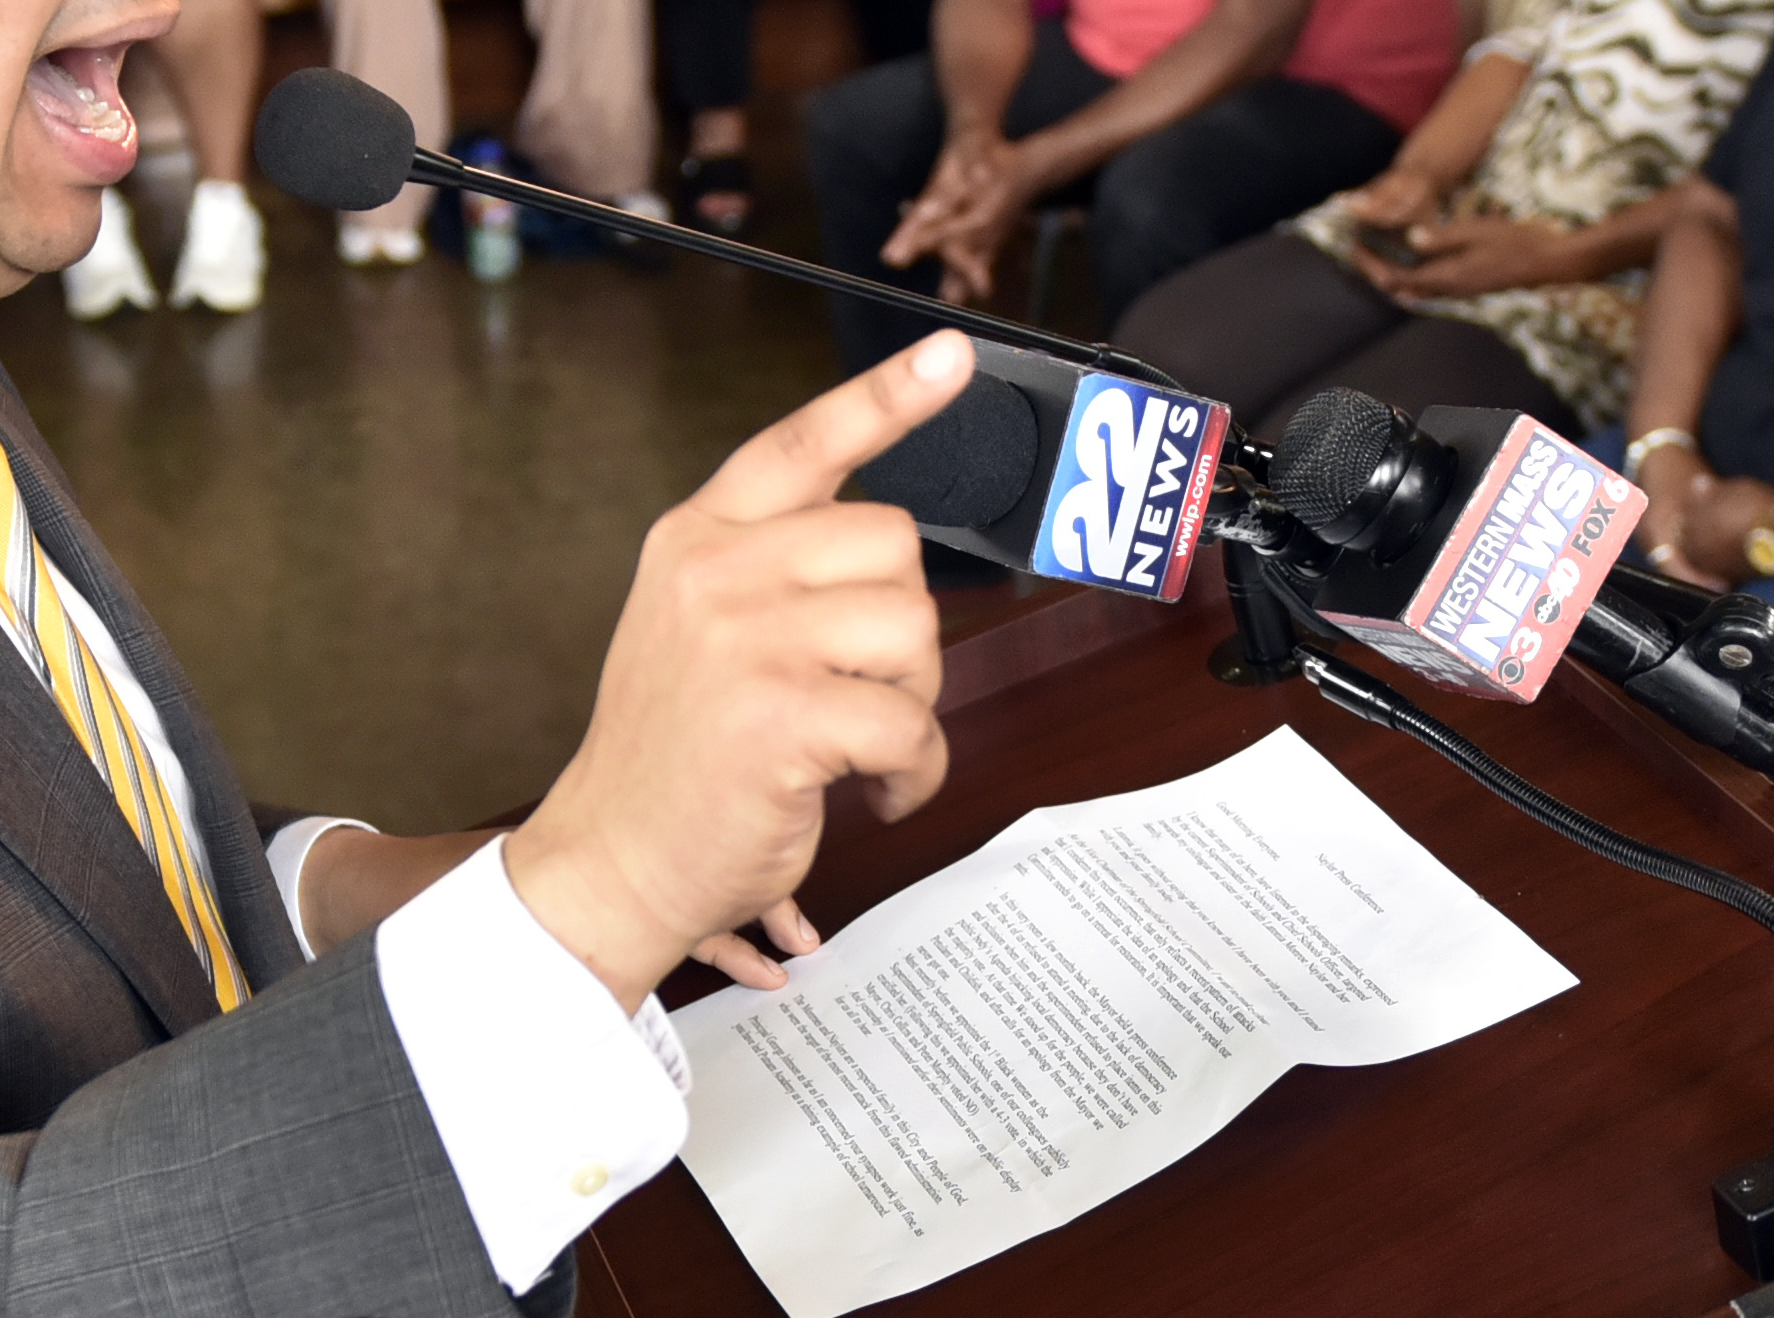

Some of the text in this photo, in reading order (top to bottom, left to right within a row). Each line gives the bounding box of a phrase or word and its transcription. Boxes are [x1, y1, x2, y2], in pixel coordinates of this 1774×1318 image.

[1052, 387, 1170, 580] 22
[1126, 405, 1199, 587] NEWS
[1175, 454, 1213, 557] wwlp.com
[1430, 516, 1515, 635] WESTERN
[1496, 440, 1558, 523] MASS
[1458, 462, 1595, 663] NEWS
